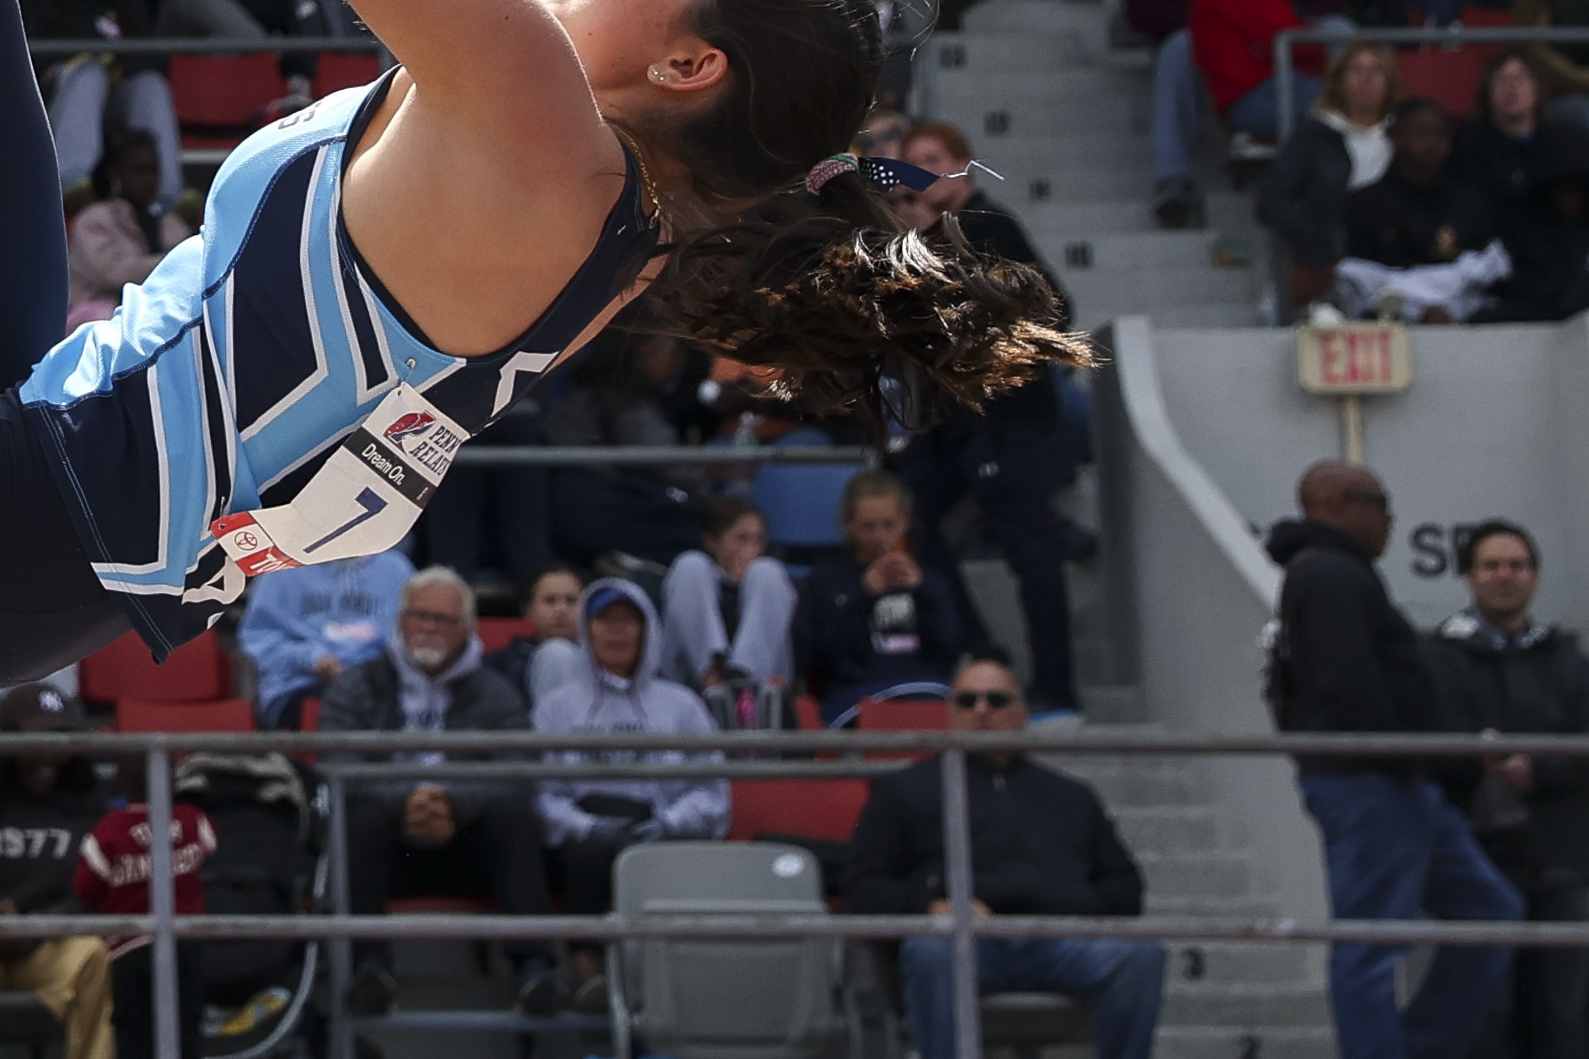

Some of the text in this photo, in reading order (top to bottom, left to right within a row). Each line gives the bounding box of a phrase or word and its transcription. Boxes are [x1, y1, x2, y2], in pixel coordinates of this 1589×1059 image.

[1319, 331, 1392, 386] EXIT
[361, 443, 393, 474] Dream
[428, 425, 463, 455] PENN
[302, 486, 389, 555] 7
